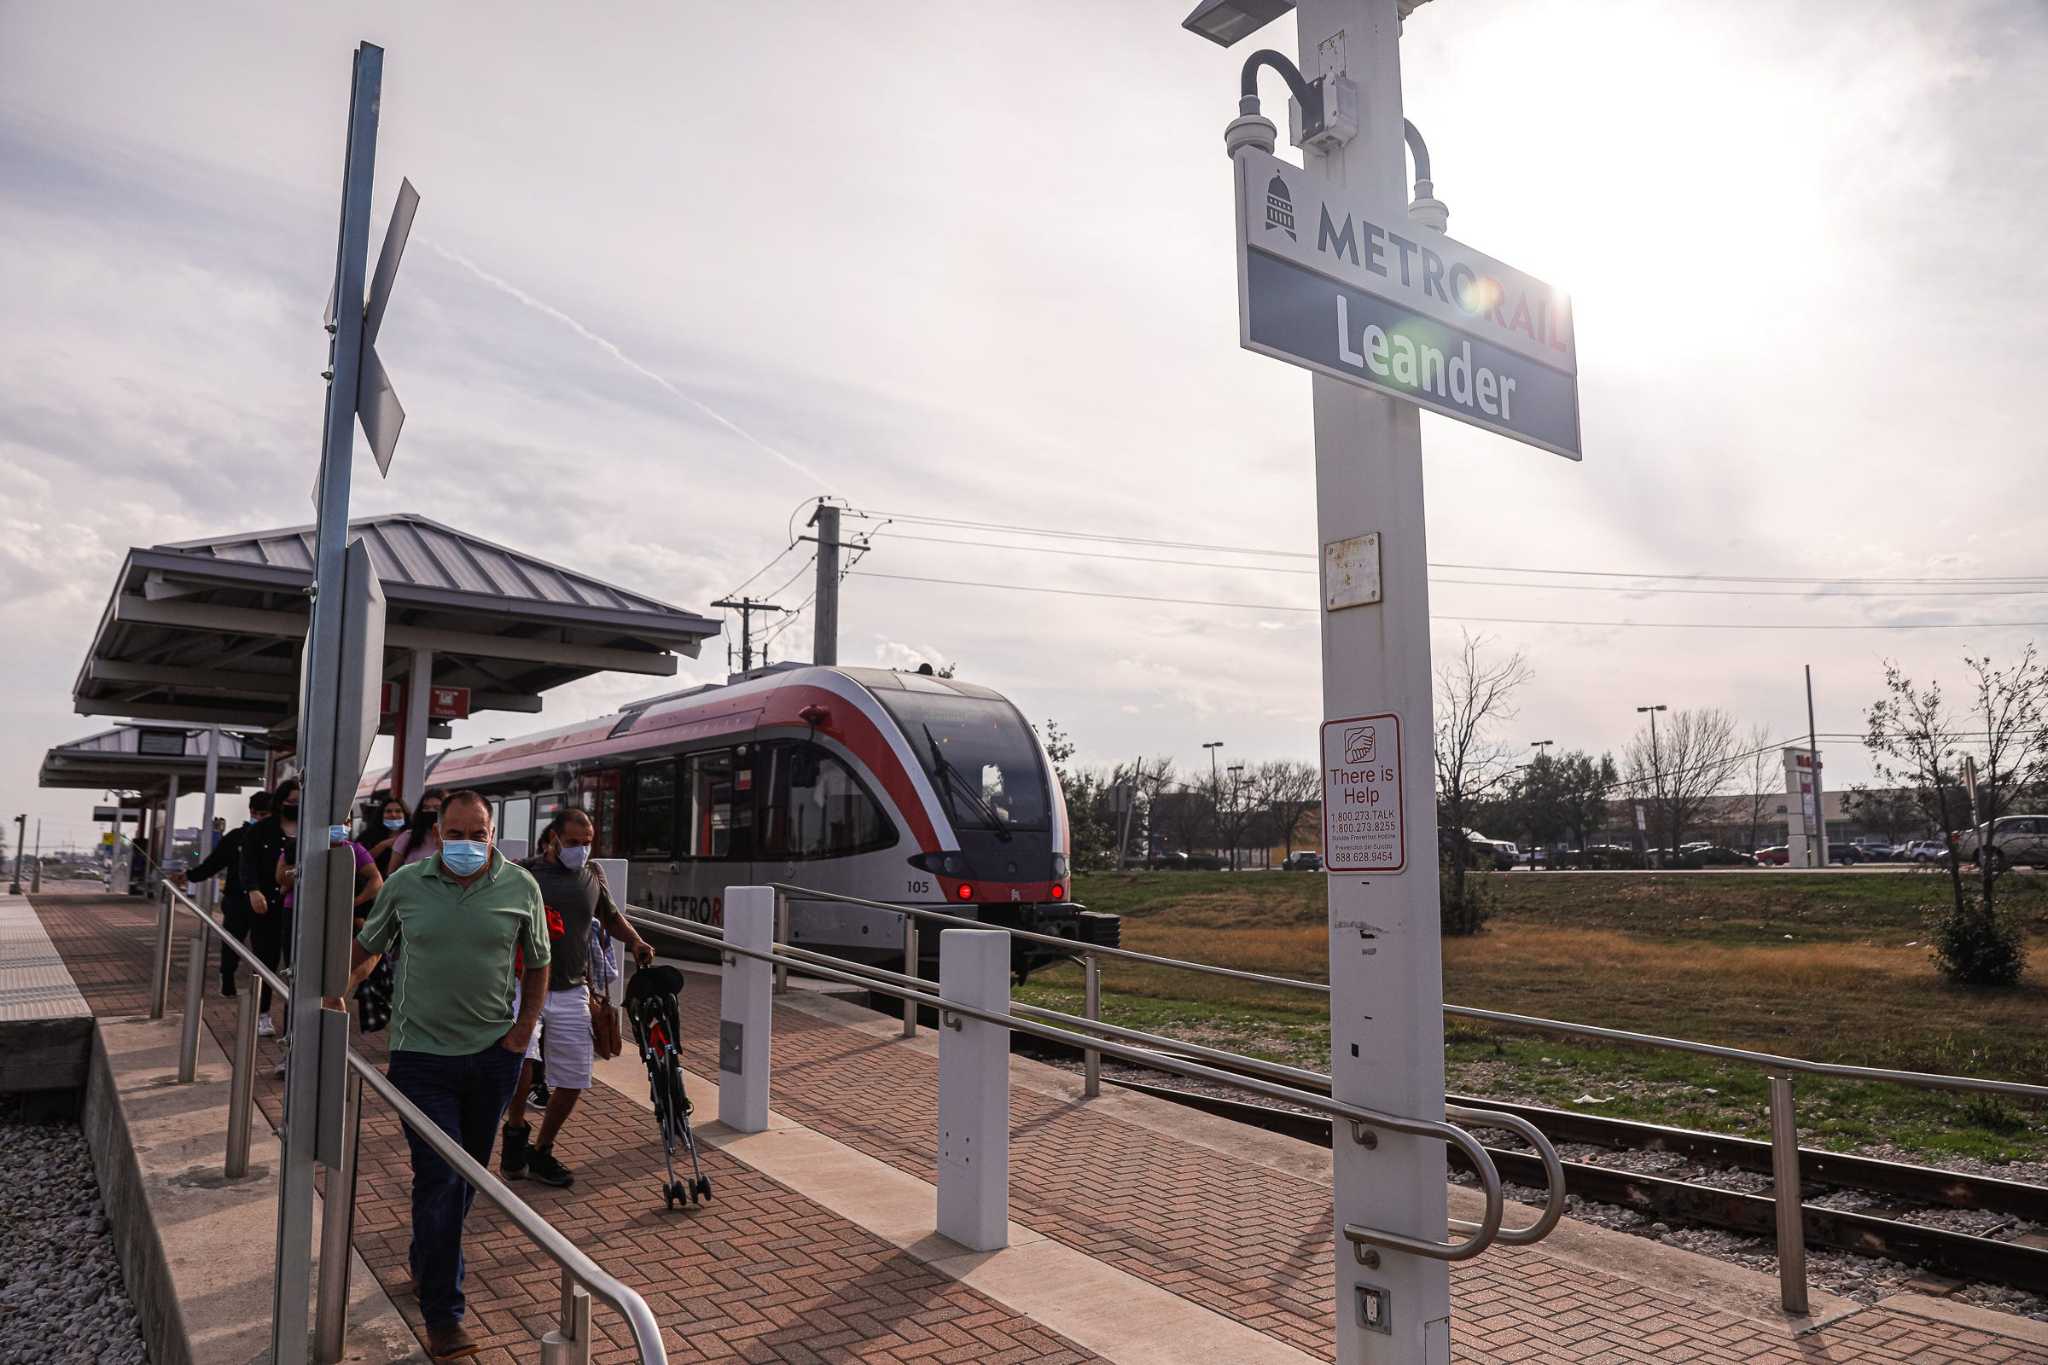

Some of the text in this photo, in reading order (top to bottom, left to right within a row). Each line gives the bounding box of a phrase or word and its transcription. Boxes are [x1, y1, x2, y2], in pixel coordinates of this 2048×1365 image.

[1317, 201, 1567, 352] METRORAIL
[1337, 295, 1516, 420] Leander
[1329, 765, 1394, 785] There is
[1344, 786, 1380, 807] Help
[907, 881, 929, 893] 105
[656, 895, 722, 924] METROR
